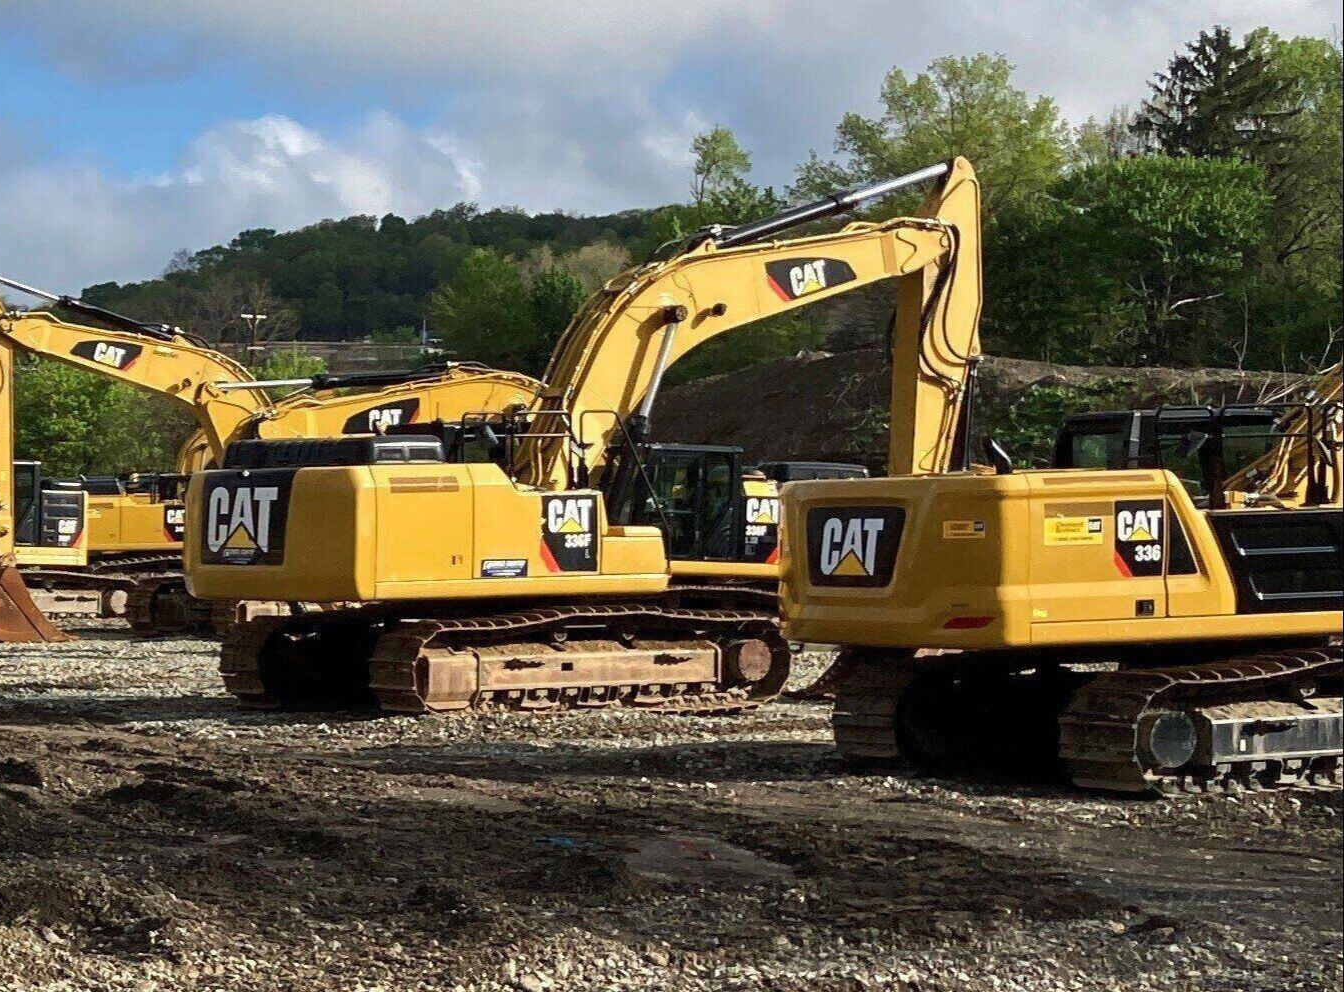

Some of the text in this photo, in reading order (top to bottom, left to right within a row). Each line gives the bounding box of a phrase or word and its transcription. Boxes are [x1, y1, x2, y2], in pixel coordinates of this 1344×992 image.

[789, 260, 826, 296] CAT
[94, 342, 126, 368] CAT
[369, 409, 403, 432] CAT
[207, 486, 279, 553] CAT
[548, 498, 593, 533] CAT
[746, 498, 779, 524] CAT
[1117, 510, 1162, 541] CAT
[820, 517, 885, 576] CAT
[1134, 544, 1162, 561] 336
